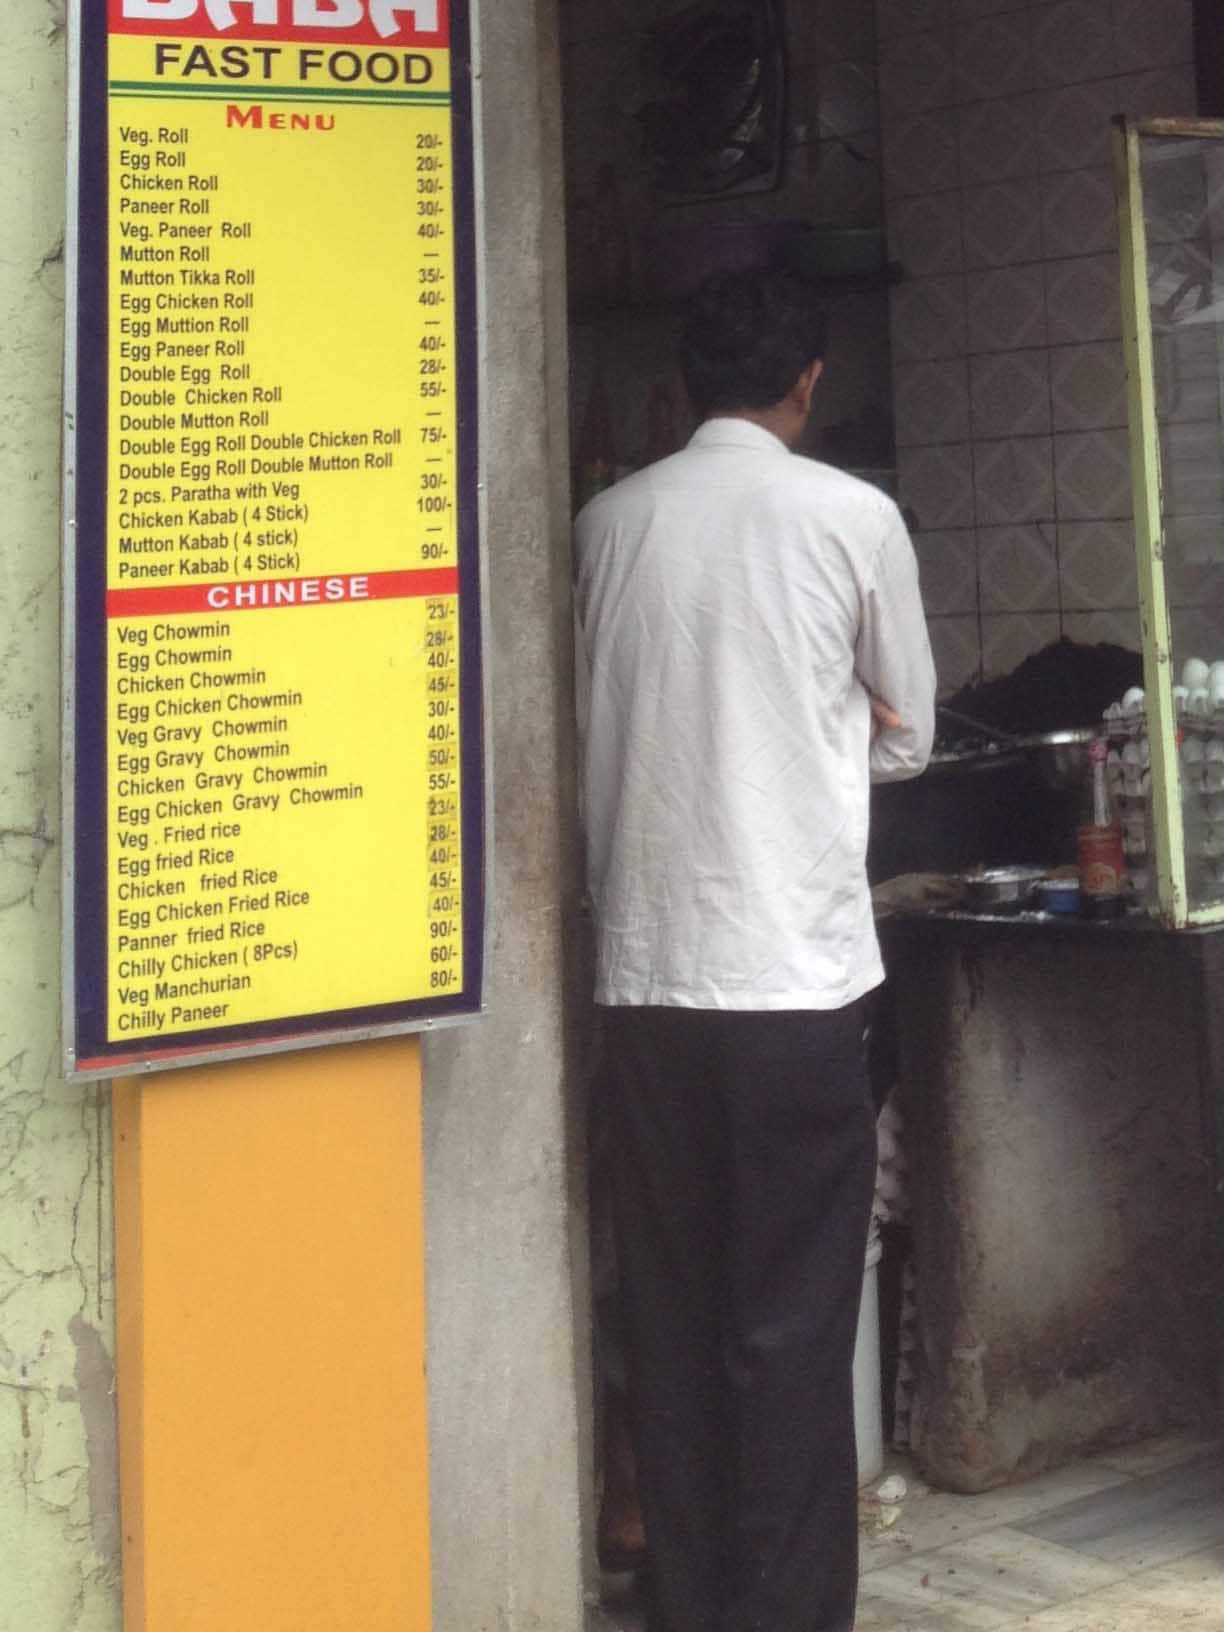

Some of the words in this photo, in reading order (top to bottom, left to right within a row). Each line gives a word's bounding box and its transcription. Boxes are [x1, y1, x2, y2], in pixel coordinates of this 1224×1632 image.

[155, 43, 281, 80] FAST
[299, 48, 433, 85] FOOD
[158, 127, 188, 144] Roll
[416, 134, 442, 149] 20/-
[120, 150, 150, 171] Egg
[156, 151, 185, 167] Roll
[416, 156, 443, 171] 20/-
[120, 174, 183, 190] Chicken
[188, 175, 218, 191] Roll
[417, 178, 443, 194] 30/-
[120, 197, 175, 214] Paneer
[180, 198, 209, 214] Roll
[417, 201, 443, 216] 30/-
[159, 222, 212, 238] Paneer
[221, 222, 251, 238] Roll
[418, 223, 444, 238] 40/-
[120, 245, 174, 262] Mutton
[179, 246, 209, 262] Roll
[120, 269, 174, 285] Mutton
[179, 269, 220, 285] Tikka
[225, 269, 254, 285] Roll
[419, 268, 444, 283] 35/-
[120, 293, 151, 314] Egg
[156, 293, 218, 309] Chicken
[224, 293, 253, 309] Roll
[418, 291, 445, 306] 40/-
[120, 317, 151, 338] Egg
[156, 317, 214, 333] Muttion
[219, 316, 248, 333] Roll
[120, 341, 151, 362] Egg
[156, 341, 210, 357] Paneer
[215, 340, 244, 356] Roll
[419, 336, 446, 351] 40/-
[120, 365, 176, 382] Double
[181, 365, 211, 385] Egg
[221, 364, 250, 380] Roll
[420, 359, 446, 375] 28/-
[120, 389, 175, 407] Double
[185, 388, 247, 405] Chicken
[253, 386, 282, 403] Roll
[420, 382, 446, 397] 55/-
[120, 414, 175, 431] Double
[181, 413, 234, 429] Mutton
[240, 411, 268, 427] Roll
[120, 438, 175, 455] Double
[181, 437, 211, 457] Egg
[216, 435, 246, 452] Roll
[251, 433, 304, 450] Double
[309, 431, 368, 448] Chicken
[373, 429, 401, 445] Roll
[420, 427, 447, 443] 75/-
[119, 488, 128, 504] 2
[171, 484, 230, 502] Paratha
[236, 482, 267, 499] with
[272, 481, 299, 501] Veg
[421, 473, 447, 490] 30/-
[119, 512, 183, 529] Chicken
[189, 508, 238, 525] Kabab
[417, 496, 452, 512] 100/-
[119, 537, 173, 554] Mutton
[179, 533, 229, 550] Kabab
[119, 562, 175, 579] Paneer
[179, 557, 229, 575] Kabab
[421, 543, 448, 559] 90/-
[207, 576, 369, 608] CHINESE
[117, 626, 147, 647] Veg
[153, 624, 230, 641] Chowmin
[117, 652, 149, 673] Egg
[155, 645, 232, 666] Chowmin
[117, 675, 184, 695] Chicken
[190, 668, 266, 688] Chowmin
[428, 651, 454, 668] 40/-
[117, 703, 149, 724] Egg
[155, 698, 221, 717] Chicken
[227, 690, 302, 711] Chowmin
[428, 676, 455, 692] 45/-
[117, 728, 148, 748] Veg
[153, 725, 202, 743] Gravy
[212, 716, 287, 737] Chowmin
[428, 700, 454, 717] 30/-
[118, 754, 150, 775] Egg
[156, 750, 204, 768] Gravy
[214, 741, 289, 762] Chowmin
[428, 724, 454, 741] 40/-
[117, 776, 184, 797] Chicken
[195, 772, 243, 790] Gravy
[253, 765, 327, 784] Chowmin
[118, 805, 150, 826] Egg
[156, 798, 222, 819] Chicken
[233, 794, 280, 811] Gravy
[290, 783, 363, 805] Chowmin
[429, 773, 456, 790] 55/-
[117, 831, 148, 851] Veg
[164, 824, 205, 843] Fried
[211, 824, 240, 838] rice
[118, 857, 150, 878] Egg
[156, 850, 192, 871] fried
[199, 848, 234, 865] Rice
[118, 880, 185, 900] Chicken
[200, 871, 237, 891] fried
[243, 868, 278, 886] Rice
[118, 909, 150, 930] Egg
[156, 901, 223, 922] Chicken
[229, 892, 269, 913] Fried
[275, 890, 309, 907] Rice
[430, 871, 456, 888] 45/-
[118, 933, 178, 952] Panner
[187, 923, 224, 944] fried
[230, 921, 265, 939] Rice
[118, 958, 165, 979] Chilly
[171, 951, 237, 972] Chicken
[430, 920, 457, 938] 90/-
[118, 987, 149, 1007] Veg
[155, 974, 251, 1000] Manchurian
[431, 945, 458, 963] 60/-
[118, 1010, 165, 1031] Chilly
[172, 1004, 229, 1024] Paneer
[431, 969, 457, 988] 80/-
